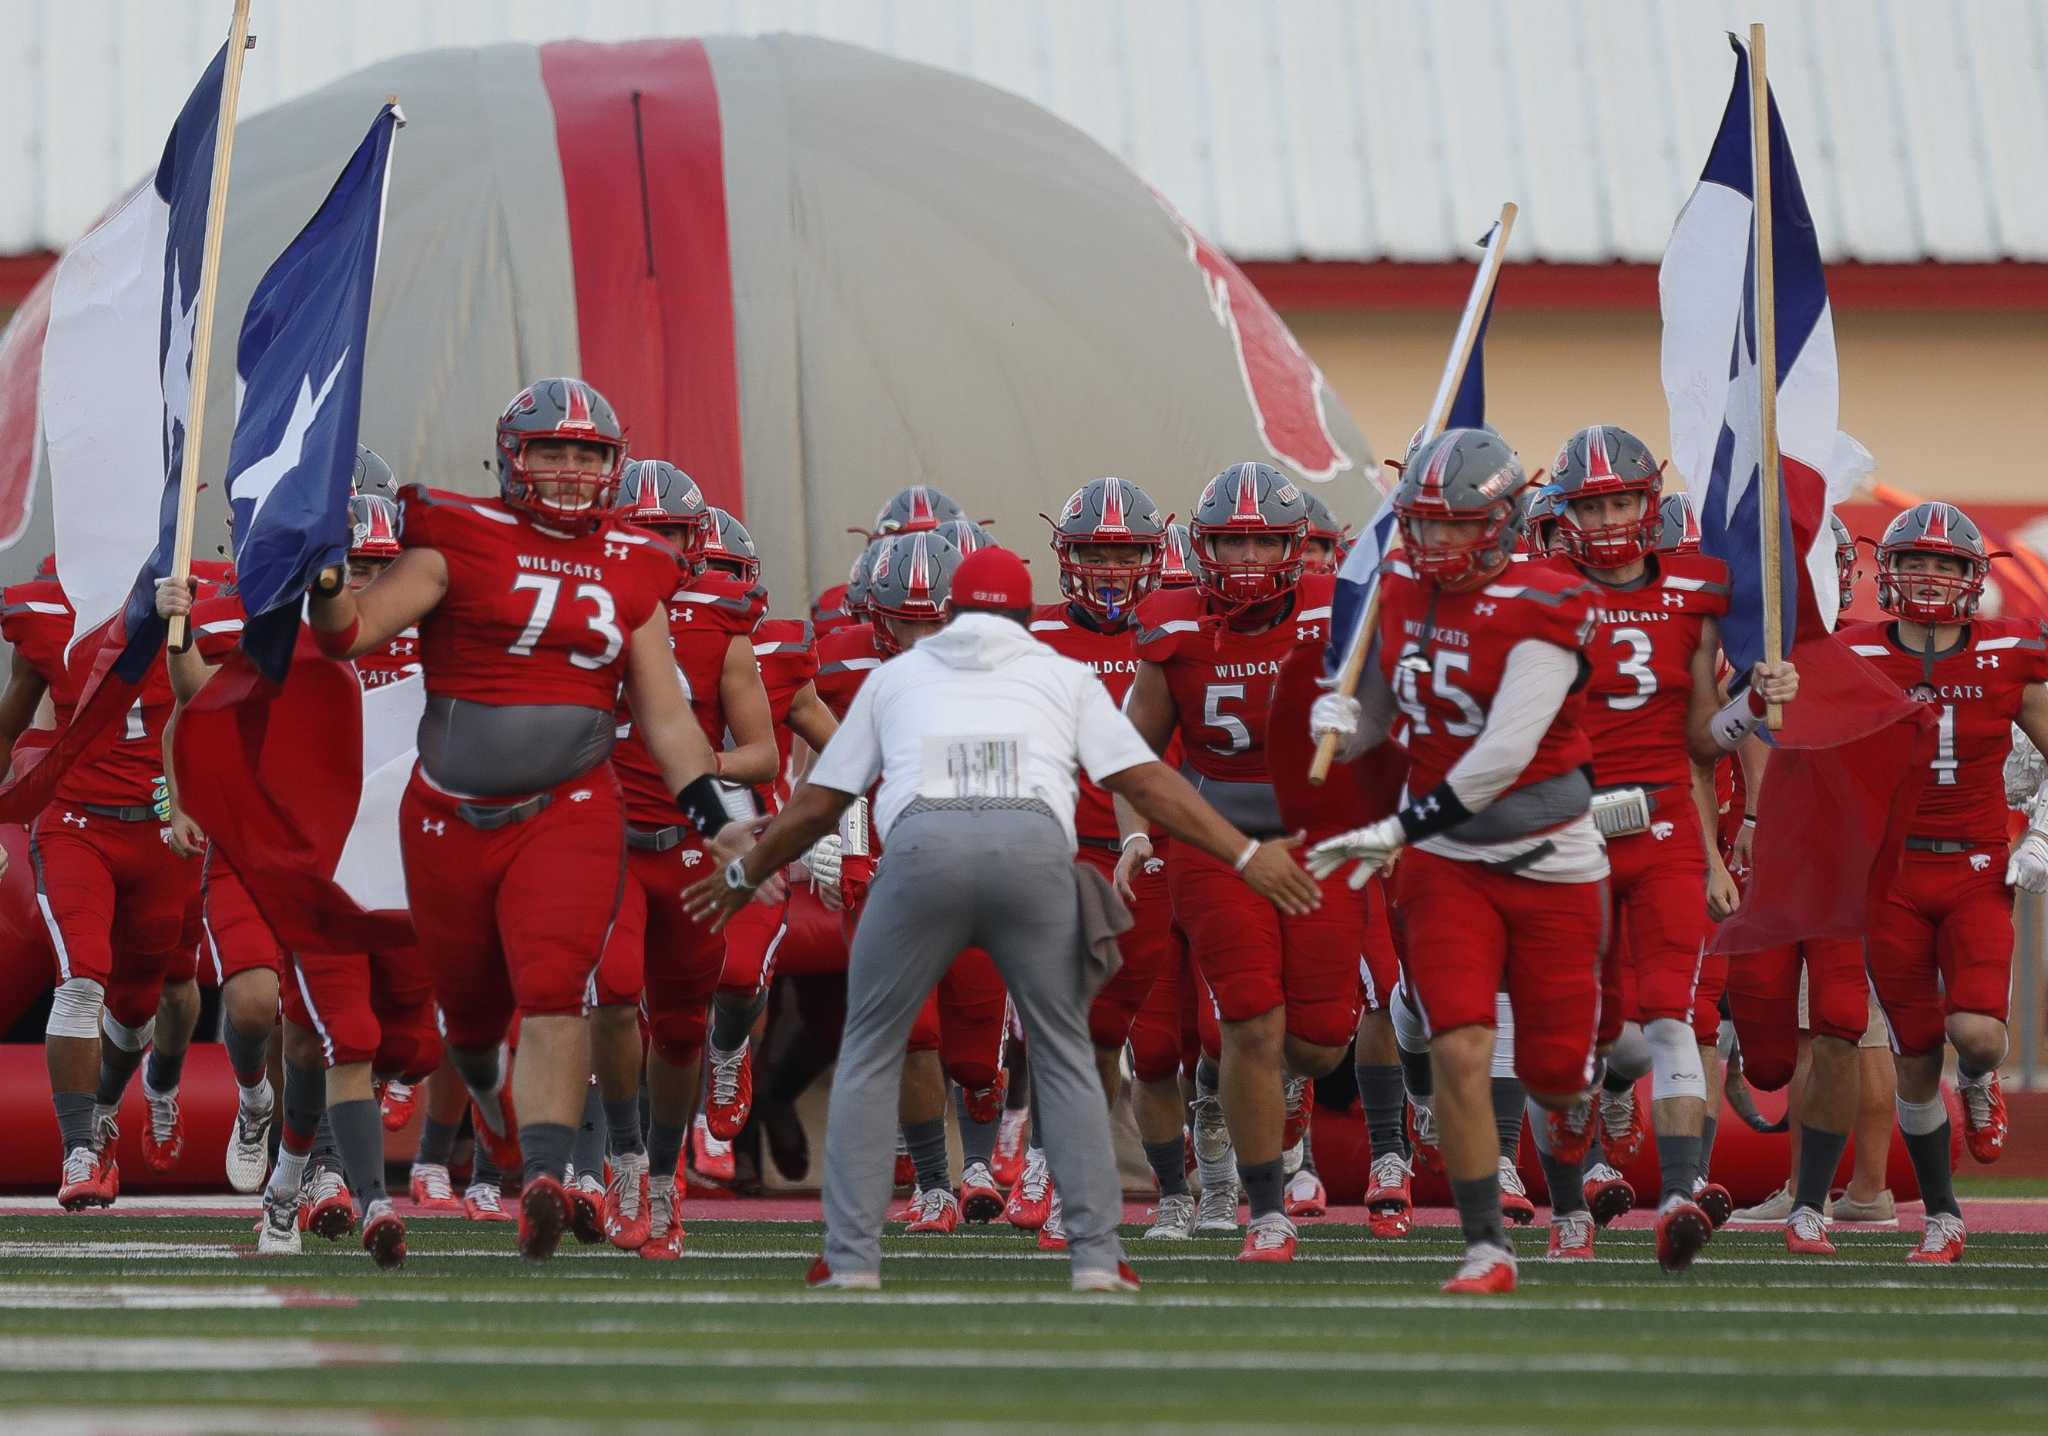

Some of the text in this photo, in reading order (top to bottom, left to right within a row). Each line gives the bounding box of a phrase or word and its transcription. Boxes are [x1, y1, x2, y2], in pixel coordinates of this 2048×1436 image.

[516, 555, 602, 581] WILDCATS
[507, 573, 624, 670] 73
[1598, 608, 1669, 623] ILDCATS
[1404, 620, 1470, 647] WIDCATS
[359, 670, 398, 684] CATS
[1215, 660, 1283, 678] WILDCA
[1608, 628, 1657, 710] 3
[1204, 683, 1275, 755] 5
